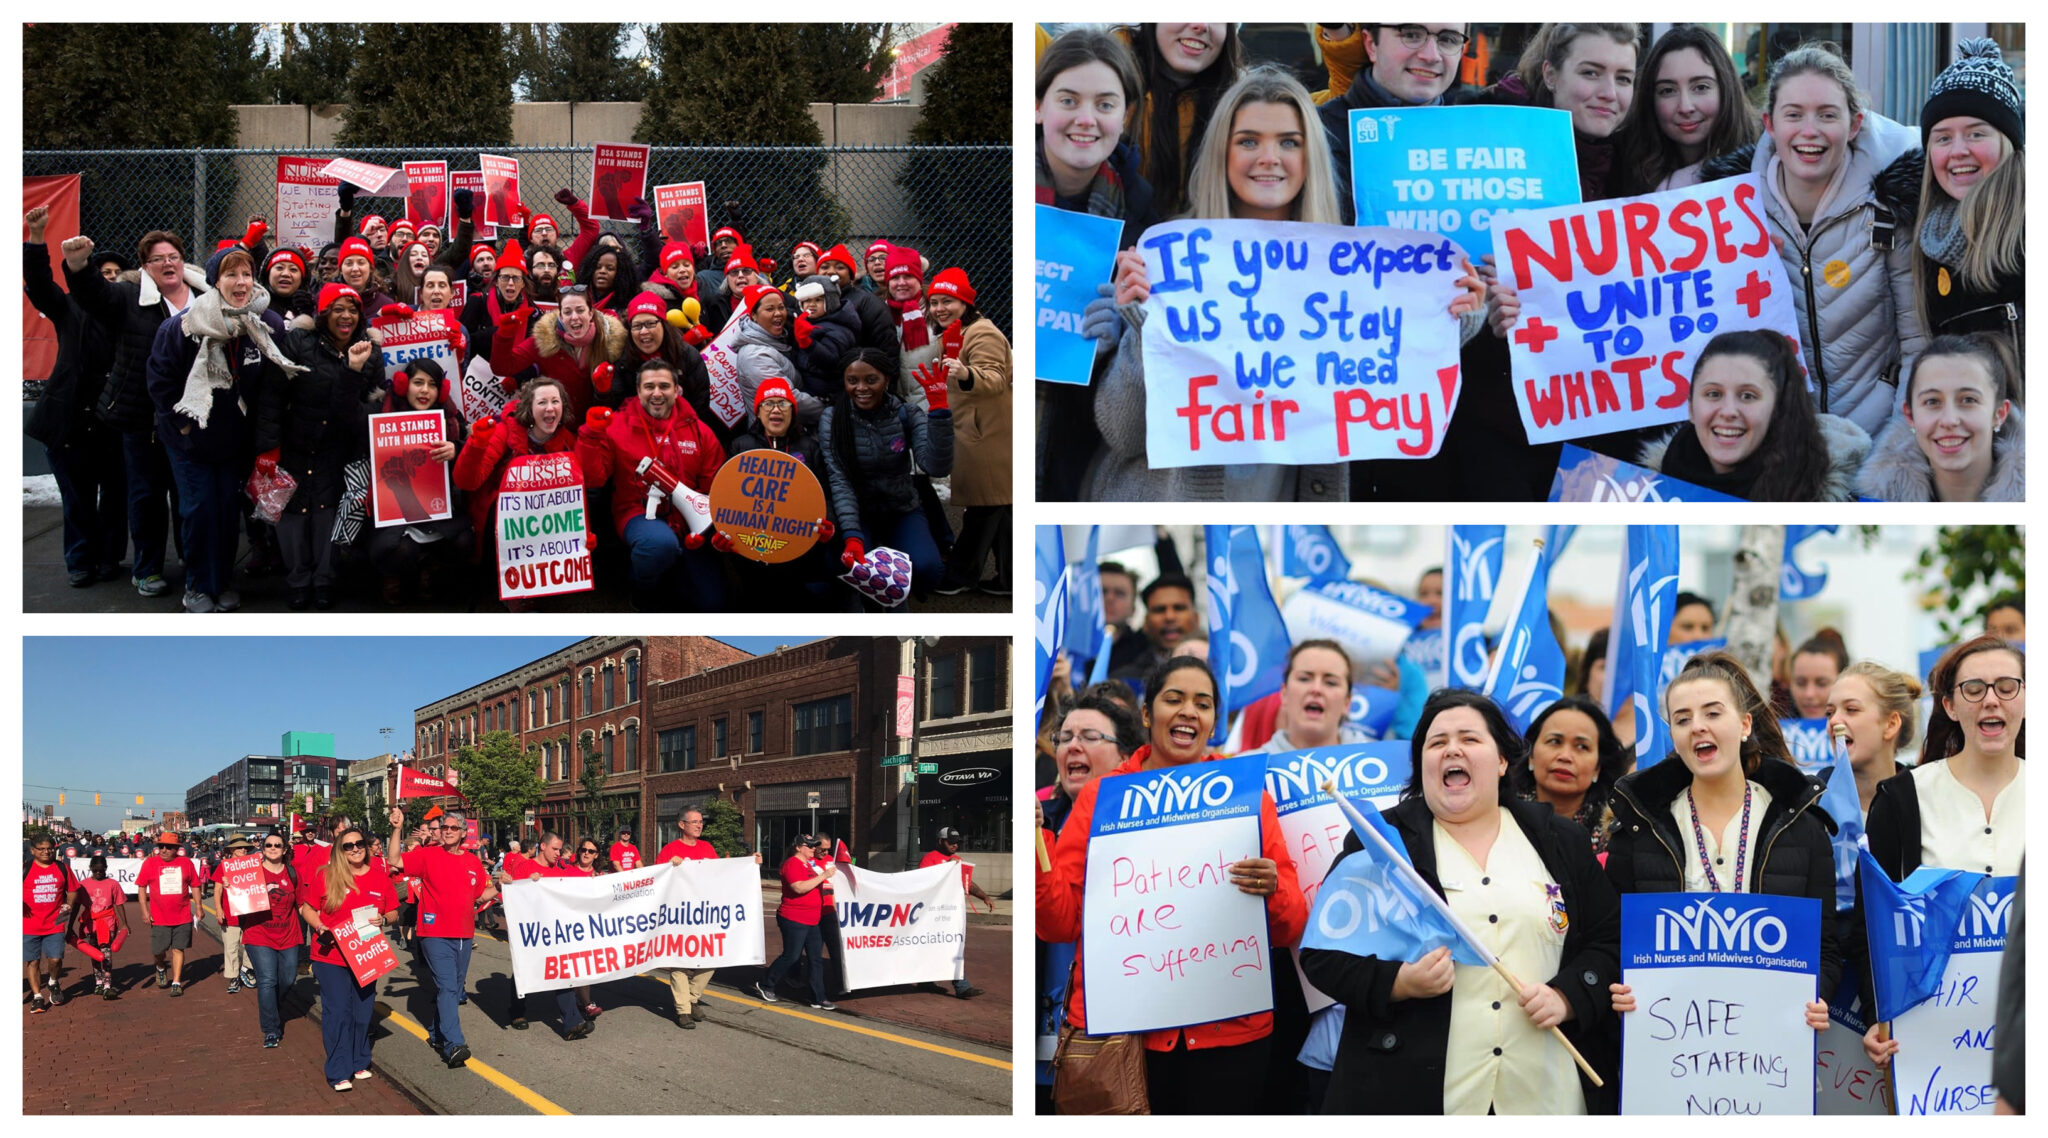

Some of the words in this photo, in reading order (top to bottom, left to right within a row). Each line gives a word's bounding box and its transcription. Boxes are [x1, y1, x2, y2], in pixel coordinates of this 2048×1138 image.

[1359, 130, 1377, 141] SU
[597, 158, 615, 166] WITH
[616, 159, 644, 168] NURSES
[600, 149, 614, 157] DSA
[615, 149, 642, 159] STANDS
[1408, 148, 1448, 171] BE
[1456, 147, 1527, 170] FAIR
[409, 167, 421, 175] DSA
[497, 161, 516, 170] STANDS
[500, 170, 517, 179] NURSES
[423, 175, 445, 183] NURSES
[1393, 179, 1435, 202] TO
[1441, 177, 1544, 201] THOSE
[280, 186, 301, 195] WE
[660, 191, 674, 199] DSA
[675, 188, 699, 198] STANDS
[677, 197, 702, 206] NURSES
[291, 220, 320, 228] NOT
[1386, 209, 1462, 233] WHO
[1504, 183, 1770, 291] NURSES
[1143, 226, 1213, 295] If
[1229, 238, 1309, 298] you
[1329, 238, 1455, 289] expect
[1567, 269, 1715, 331] UNITE
[381, 318, 446, 338] NURSES
[1166, 303, 1220, 342] us
[1239, 295, 1286, 342] to
[1300, 290, 1401, 357] Stay
[1583, 326, 1643, 363] TO
[1669, 312, 1719, 343] DO
[383, 344, 453, 367] RESPECT
[1316, 338, 1400, 386] need
[1524, 351, 1692, 429] WHAT'S
[1334, 364, 1460, 457] pay!
[379, 422, 399, 433] DSA
[400, 420, 436, 432] STANDS
[376, 435, 400, 447] WITH
[404, 432, 440, 444] NURSES
[507, 461, 572, 482] NURSES
[737, 455, 797, 480] HEALTH
[505, 476, 574, 489] ASSOCIATION
[741, 476, 791, 502] CARE
[500, 494, 521, 512] IT'S
[525, 493, 546, 511] NOT
[547, 489, 582, 507] ABOUT
[752, 500, 764, 513] IS
[765, 502, 775, 514] A
[504, 508, 585, 541] INCOME
[715, 507, 770, 530] HUMAN
[772, 515, 816, 538] RIGHT
[508, 544, 534, 561] IT'S
[540, 538, 581, 557] ABOUT
[745, 535, 777, 551] NYSNA
[504, 555, 592, 590] OUTCOME
[414, 777, 444, 787] NURSES
[943, 773, 975, 781] OTTAVA
[978, 771, 993, 779] VIA
[1120, 769, 1234, 820] INMO
[1276, 799, 1299, 814] urses
[1300, 795, 1316, 808] and
[1100, 823, 1116, 832] Irish
[1116, 819, 1144, 831] Nurses
[1145, 816, 1160, 826] and
[1161, 811, 1200, 824] Midwives
[1201, 804, 1250, 818] Organisation
[224, 857, 260, 872] Patients
[233, 872, 258, 884] over
[623, 877, 655, 891] NURSES
[612, 889, 655, 902] Association
[519, 921, 551, 947] We
[554, 918, 585, 945] Are
[588, 911, 657, 939] Nurses
[658, 900, 731, 929] Building
[735, 903, 746, 922] a
[837, 902, 924, 928] UMPNC
[1656, 896, 1788, 954] INMO
[847, 935, 894, 950] NURSES
[892, 931, 964, 947] Association
[1954, 937, 1971, 949] and
[544, 947, 620, 980] BETTER
[624, 933, 727, 968] BEAUMONT
[1633, 954, 1652, 964] Irish
[1654, 953, 1686, 963] Nurses
[1688, 952, 1705, 963] and
[1707, 952, 1753, 964] Midwives
[1755, 954, 1808, 969] Organisation
[1648, 996, 1745, 1041] SAFE
[1829, 1004, 1844, 1020] rish
[1843, 1010, 1868, 1033] Nurse
[1686, 1094, 1763, 1116] NOW
